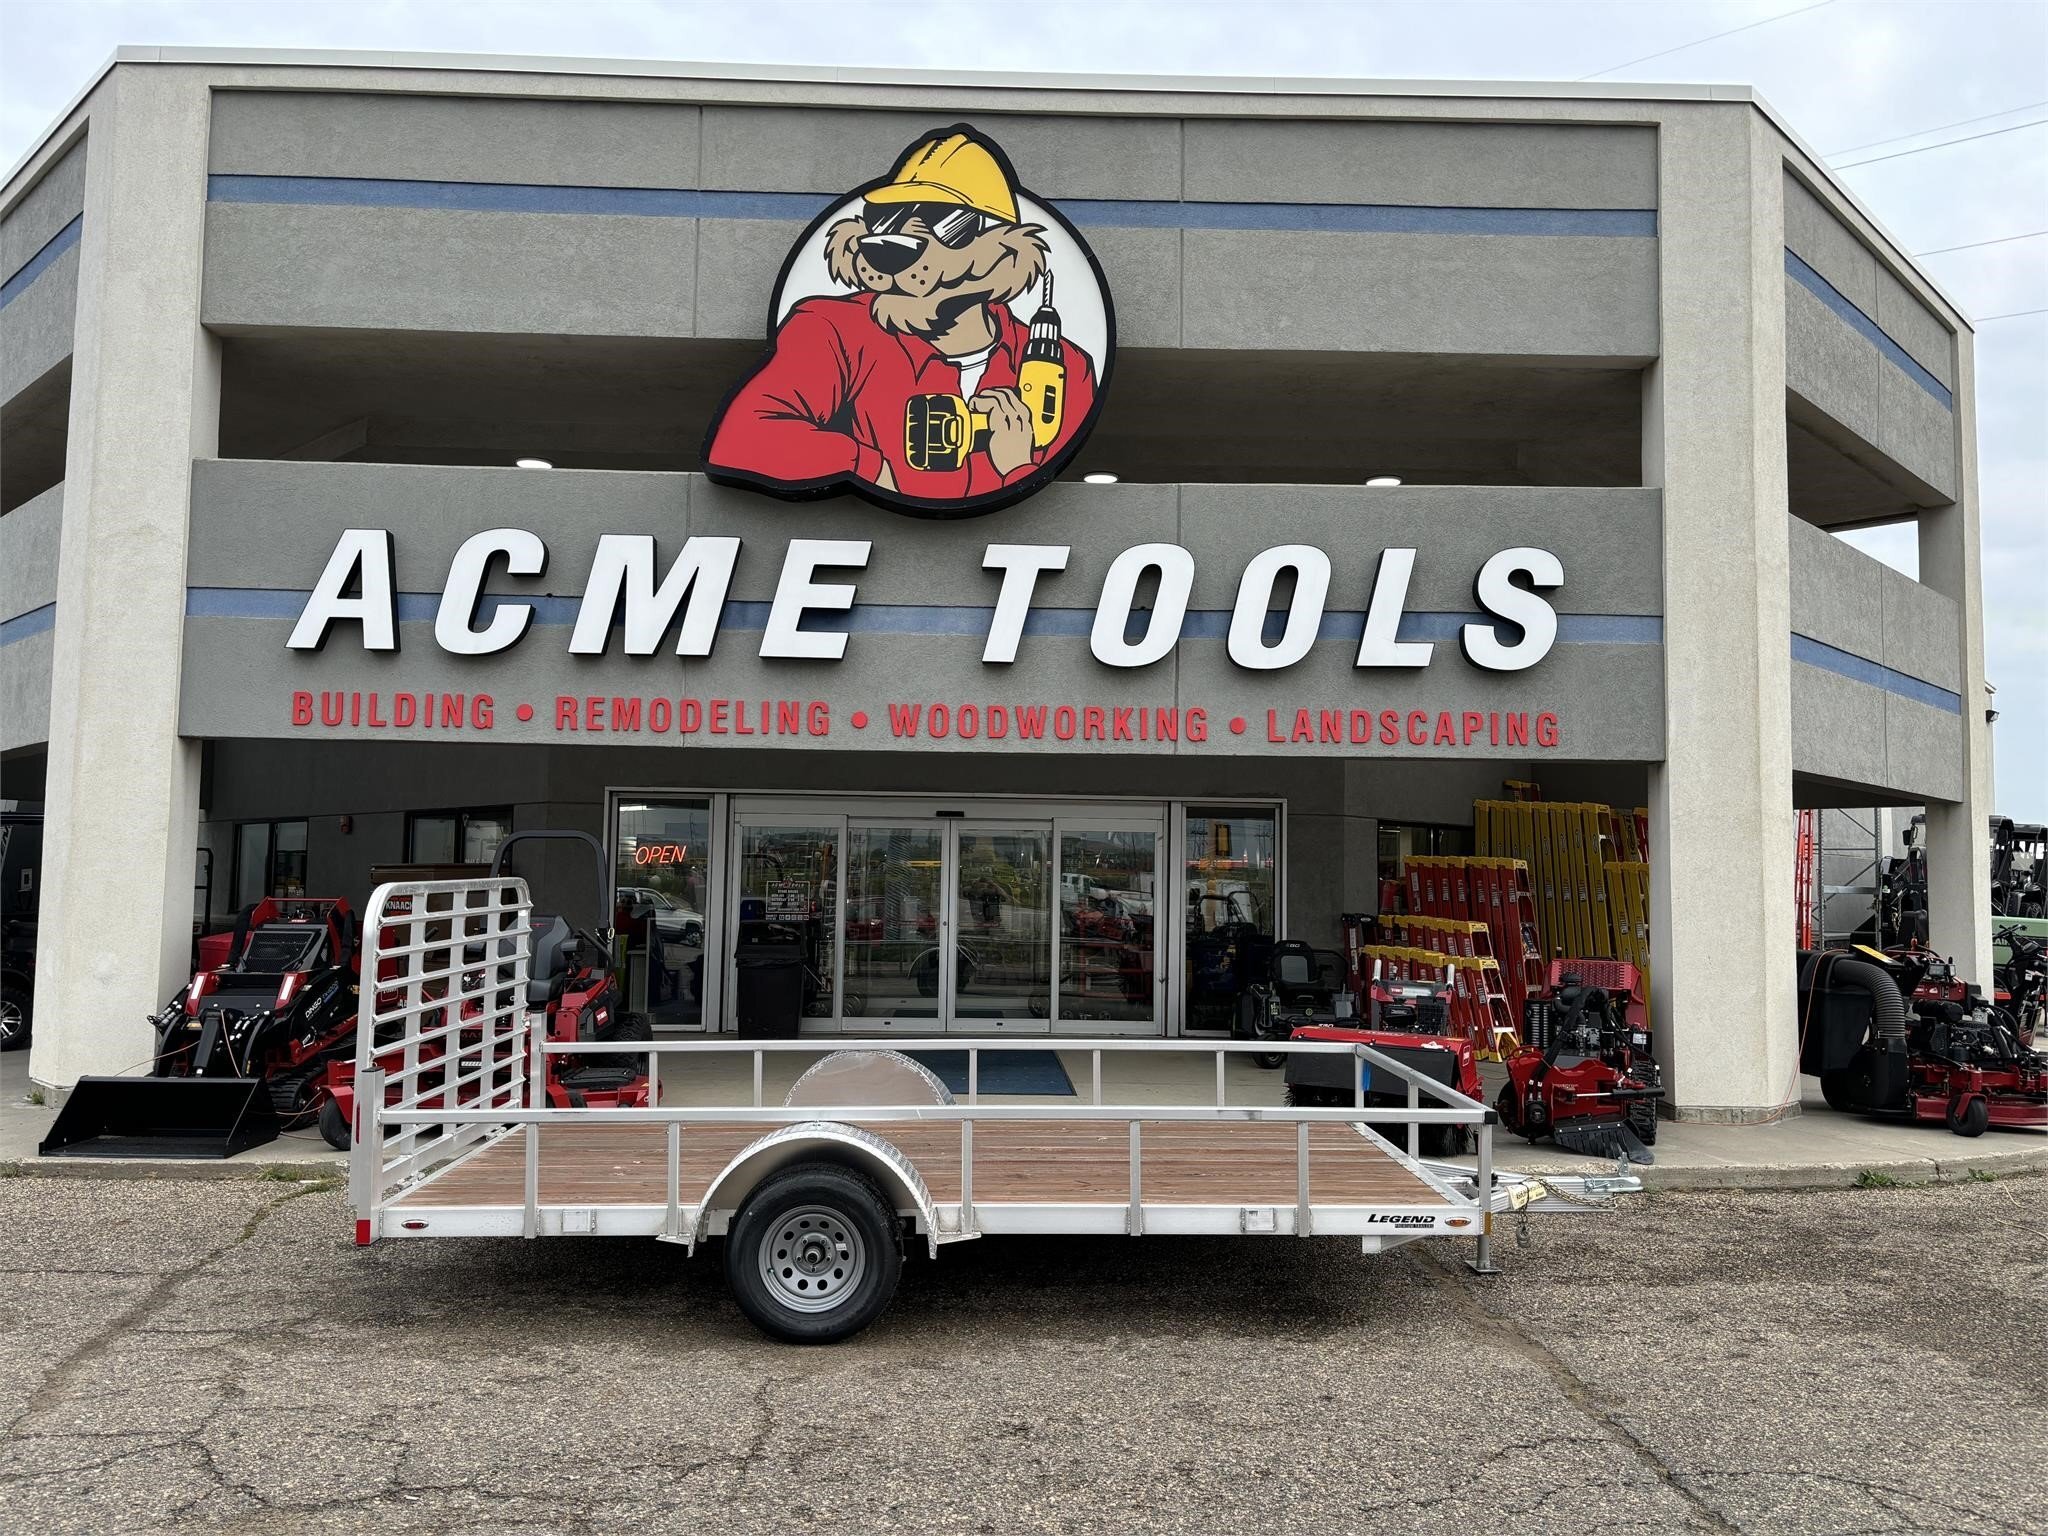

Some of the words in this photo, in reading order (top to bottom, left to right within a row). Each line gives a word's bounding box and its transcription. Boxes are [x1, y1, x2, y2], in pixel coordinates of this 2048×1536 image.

[285, 527, 874, 660] ACME
[981, 542, 1566, 672] TOOLS
[292, 691, 494, 730] BUILDING
[555, 696, 830, 737] REMODELING
[889, 703, 1209, 742] WOODWORKING
[1267, 708, 1559, 747] LANDSCAPING
[635, 845, 687, 865] OPEN
[305, 997, 322, 1018] DINGO
[1367, 1213, 1436, 1223] LEGEND
